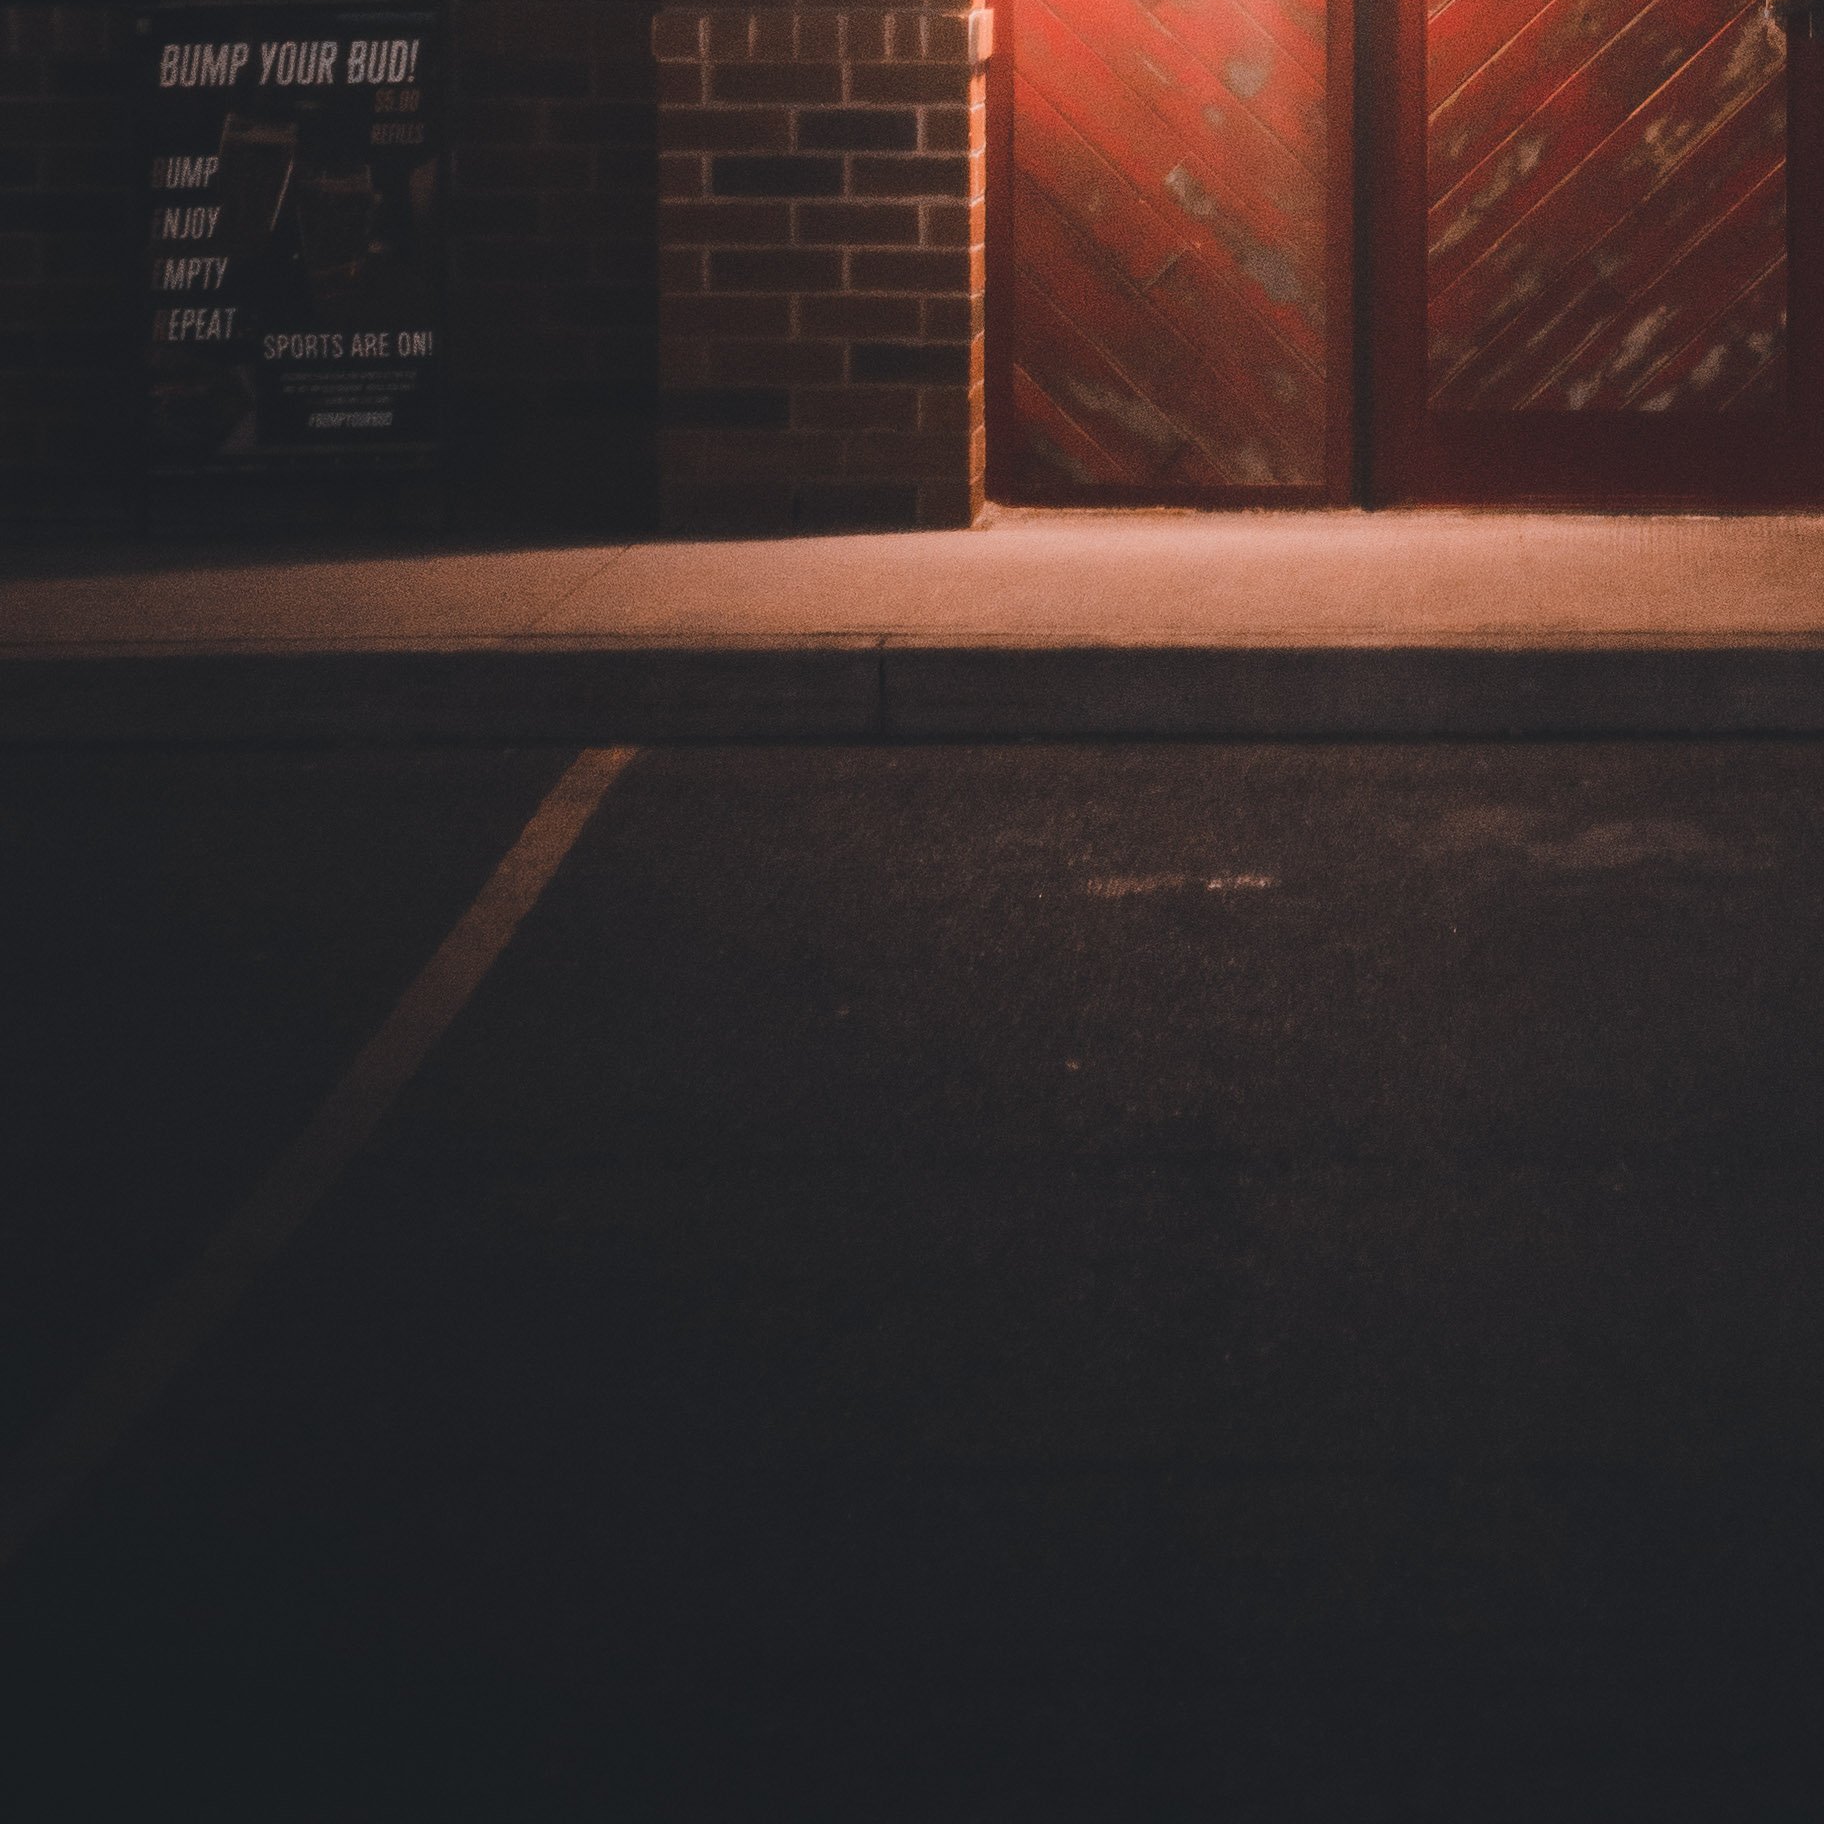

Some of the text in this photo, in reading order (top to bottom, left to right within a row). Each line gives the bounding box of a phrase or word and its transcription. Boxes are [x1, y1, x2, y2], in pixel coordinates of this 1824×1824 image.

[159, 38, 421, 88] BUMP YOUR BUD!
[151, 154, 219, 190] BUMP
[150, 205, 222, 240] ENJOY
[150, 255, 229, 291] EMPTY
[263, 330, 433, 361] SPORTS ARE ON!
